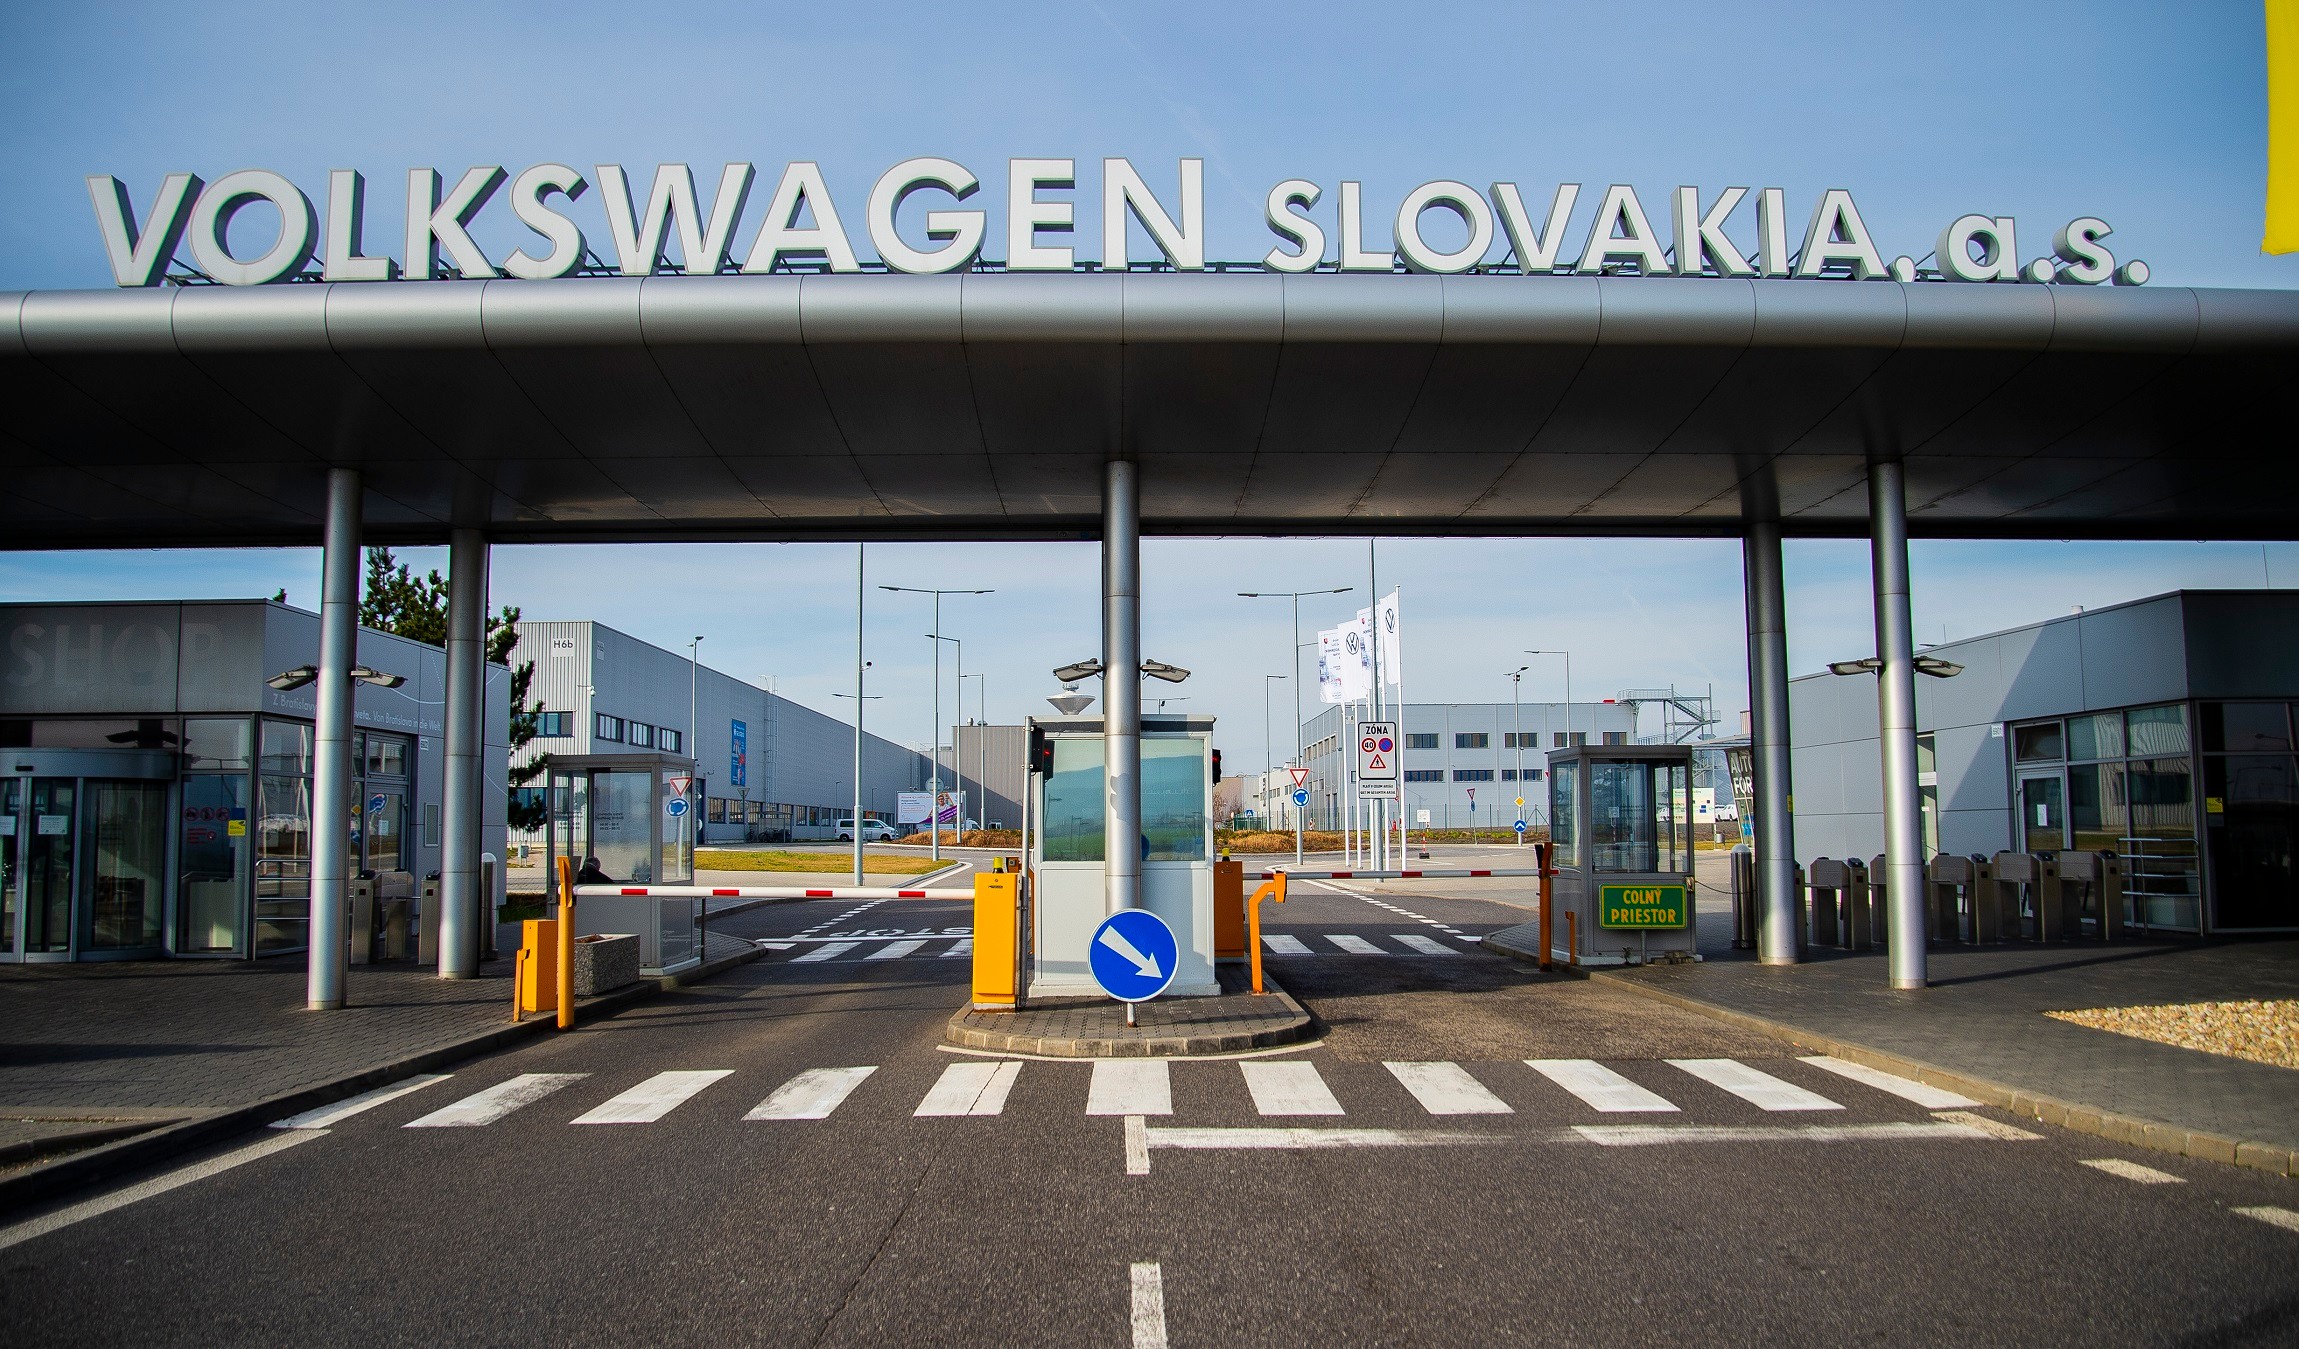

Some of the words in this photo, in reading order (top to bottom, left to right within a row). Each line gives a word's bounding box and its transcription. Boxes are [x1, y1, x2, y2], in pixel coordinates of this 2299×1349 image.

[86, 157, 1204, 287] VOLKSWAGEN
[1263, 179, 1917, 283] SLOVAKIA,
[1936, 213, 2151, 286] a.s.
[553, 639, 574, 649] H6b
[7, 622, 226, 688] SHOP
[355, 710, 371, 720] veta.
[373, 710, 385, 723] Von
[412, 717, 419, 728] in
[1365, 724, 1389, 735] ZÓNA
[1731, 755, 1753, 774] AUT
[1623, 886, 1662, 905] COLNÝ
[1611, 908, 1676, 924] PRIESTOR
